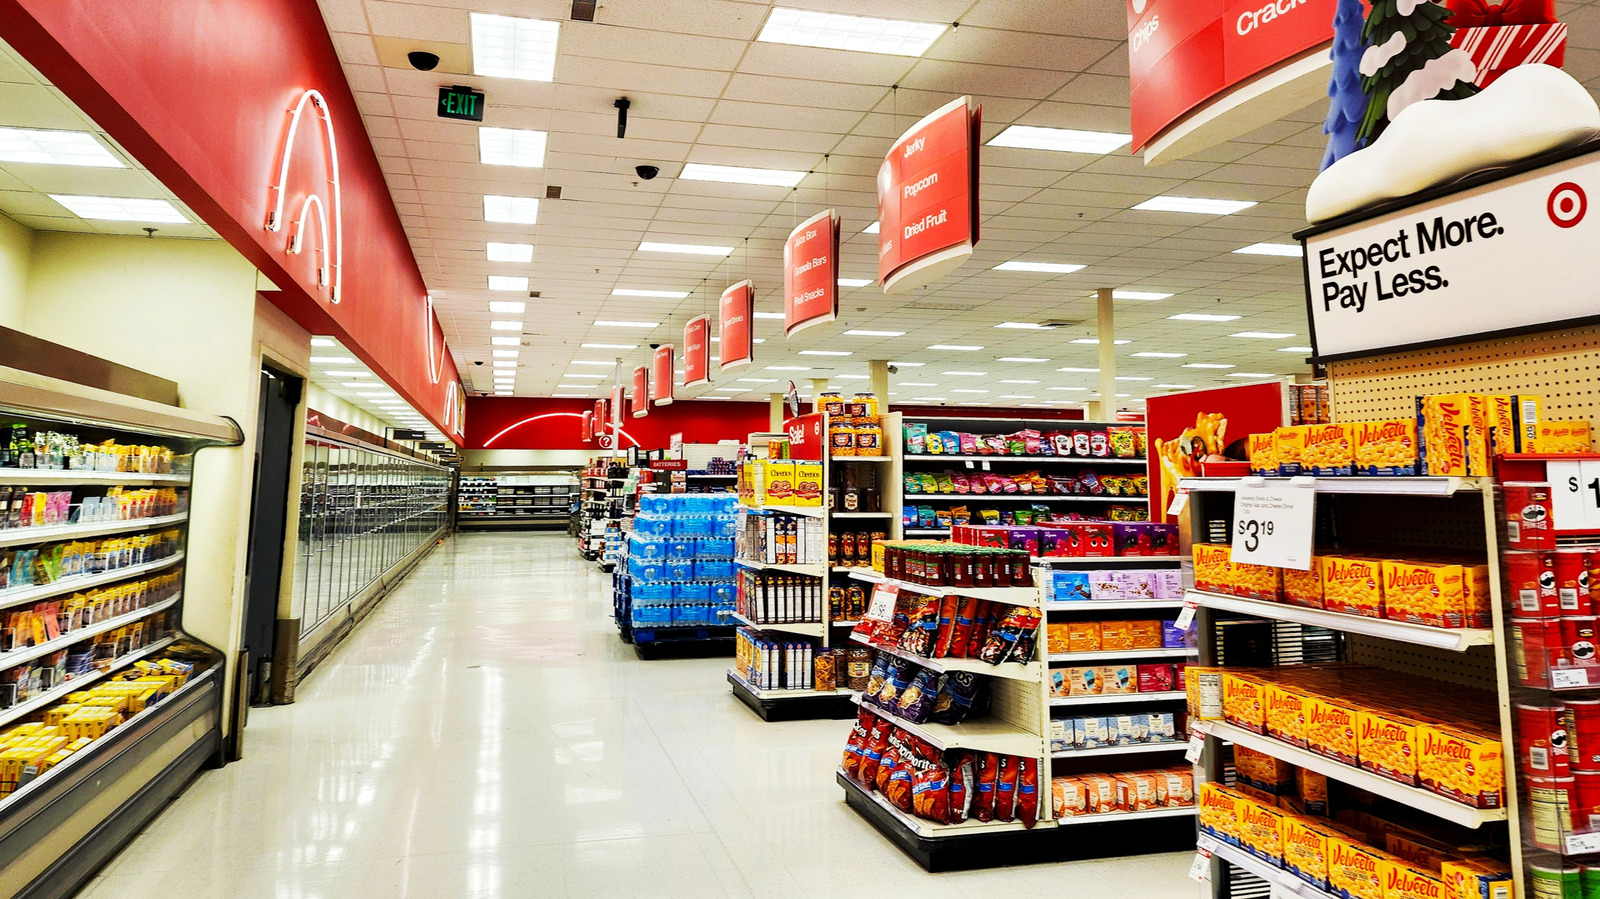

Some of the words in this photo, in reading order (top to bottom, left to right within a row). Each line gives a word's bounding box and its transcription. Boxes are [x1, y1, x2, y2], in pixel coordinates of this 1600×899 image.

[1133, 15, 1159, 52] Chips
[447, 92, 477, 116] EXIT
[904, 137, 925, 158] Jerky
[904, 173, 938, 199] Popcorn
[806, 229, 817, 241] Box
[904, 218, 925, 239] Dried
[926, 209, 947, 229] Fruit
[1319, 229, 1411, 280] Expect
[1416, 211, 1505, 254] More.
[812, 256, 827, 268] Bars
[804, 288, 825, 302] Snacks
[1322, 279, 1367, 313] Pay
[1375, 265, 1449, 303] Less.
[1468, 395, 1484, 436] Velveeta
[1495, 397, 1512, 436] Velveeta
[789, 424, 805, 445] Sale!
[1304, 425, 1345, 449] Velveeta
[1359, 421, 1407, 447] Velveeta
[1439, 402, 1463, 469] Velveeta
[1196, 548, 1229, 566] Velveeta
[1328, 561, 1371, 583] Velveeta
[1389, 566, 1436, 589] Velveeta
[1227, 679, 1258, 698] Velveeta
[1270, 691, 1302, 711] Velveeta
[1311, 704, 1350, 726] Velveeta
[1362, 718, 1407, 742] Velveeta
[1424, 733, 1471, 760] Velveeta
[1203, 789, 1235, 811] Velveeta
[1242, 805, 1277, 829] Velveeta
[1287, 823, 1321, 849] Velveeta
[1333, 844, 1376, 873] Velveeta
[1388, 867, 1440, 899] Velveeta
